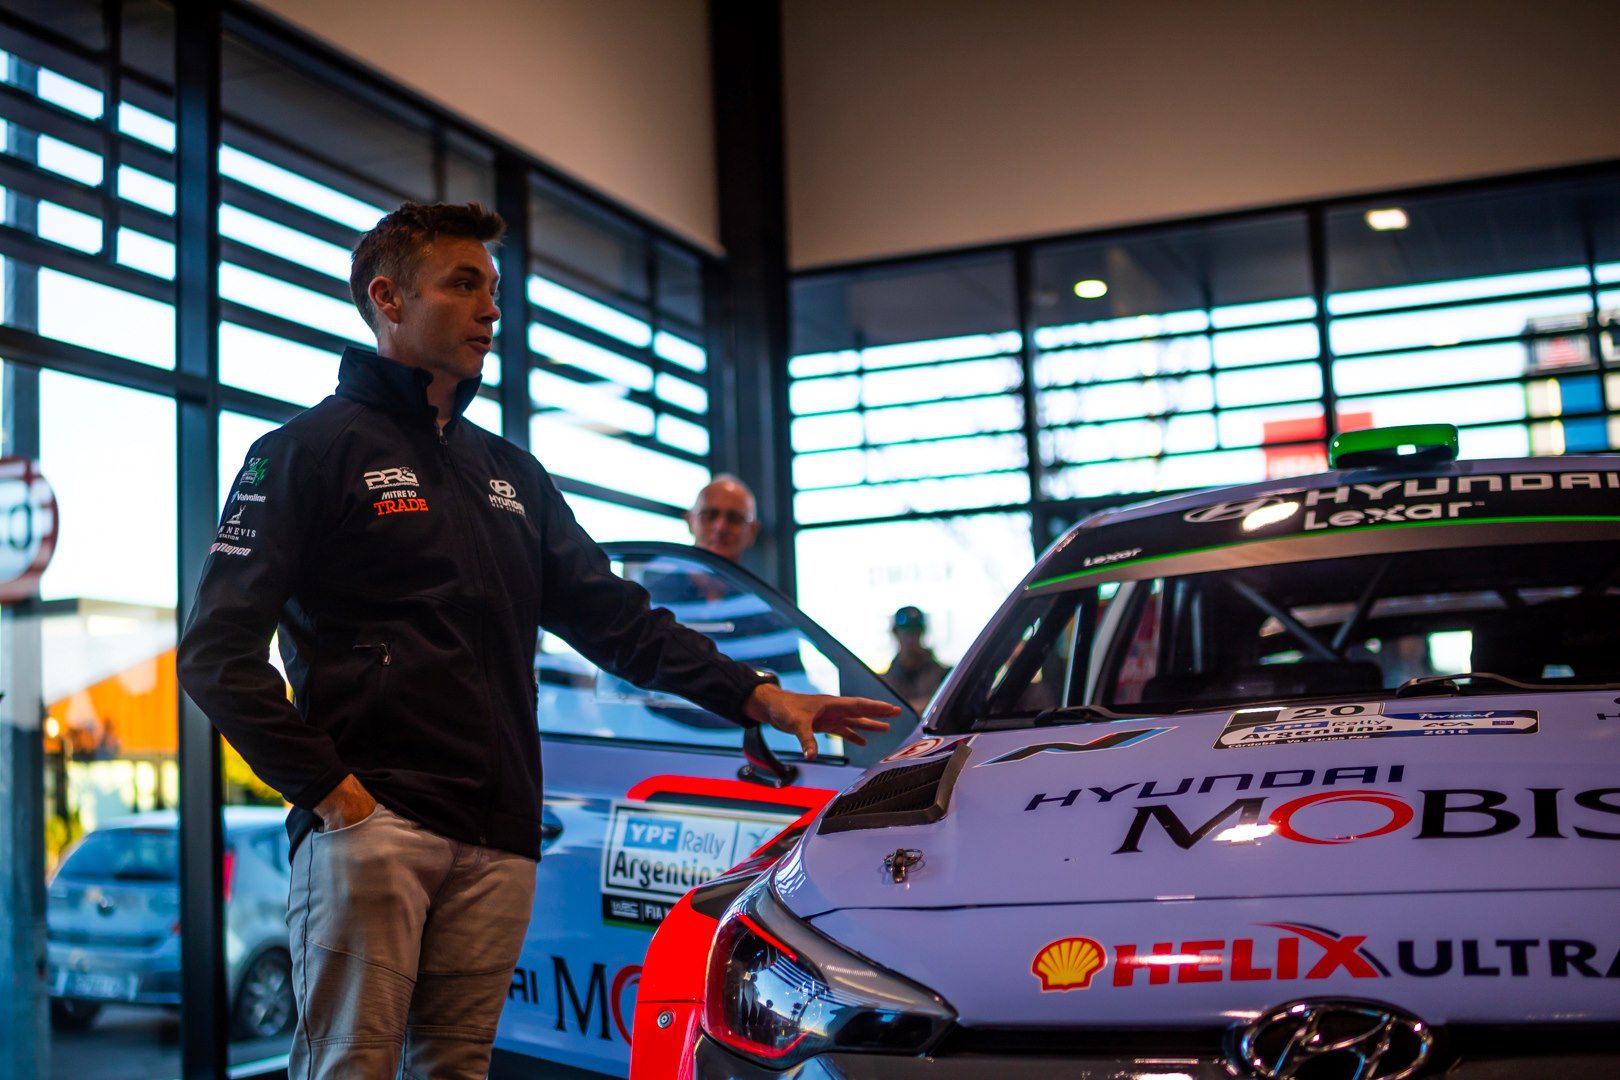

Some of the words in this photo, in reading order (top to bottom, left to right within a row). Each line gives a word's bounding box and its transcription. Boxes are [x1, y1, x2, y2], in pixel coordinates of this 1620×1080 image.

[236, 493, 267, 503] Valvoline
[381, 490, 408, 500] MITRE
[407, 489, 417, 498] 10
[1305, 471, 1620, 507] HYUNDAI
[373, 498, 429, 516] TRADE
[1303, 500, 1473, 531] Lexar
[226, 527, 257, 538] NEVIS
[1291, 705, 1365, 719] 20
[1332, 719, 1386, 727] Rally
[1239, 725, 1393, 741] Argentina
[1023, 764, 1405, 811] HYUNDAI
[630, 822, 677, 845] YPF
[681, 829, 726, 859] Rally
[612, 850, 724, 888] Argentin
[1112, 922, 1391, 987] HELIX
[1397, 937, 1620, 979] ULTR
